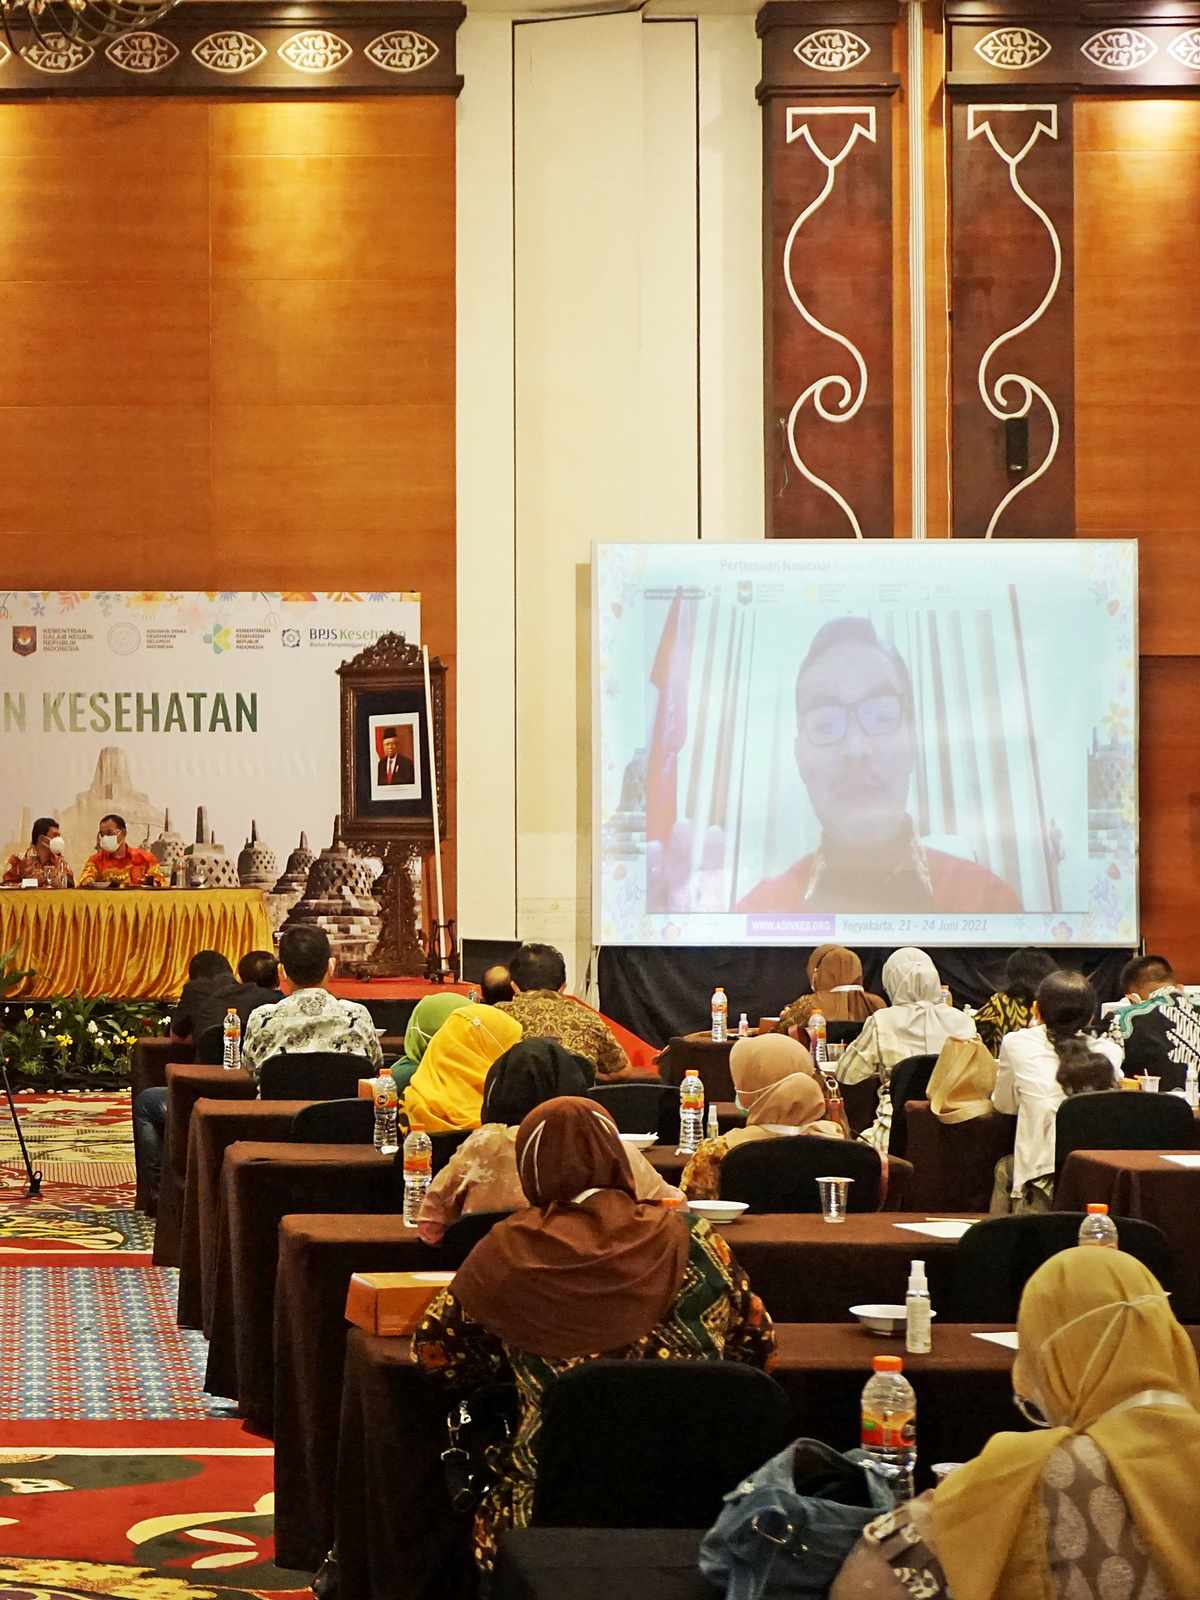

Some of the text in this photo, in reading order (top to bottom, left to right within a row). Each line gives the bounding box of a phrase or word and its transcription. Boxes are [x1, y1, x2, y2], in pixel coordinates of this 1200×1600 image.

[309, 628, 338, 641] BPJS
[42, 692, 258, 733] KESEHATAN
[922, 919, 936, 931] 24
[939, 919, 959, 931] Juni
[961, 919, 988, 932] 2021
